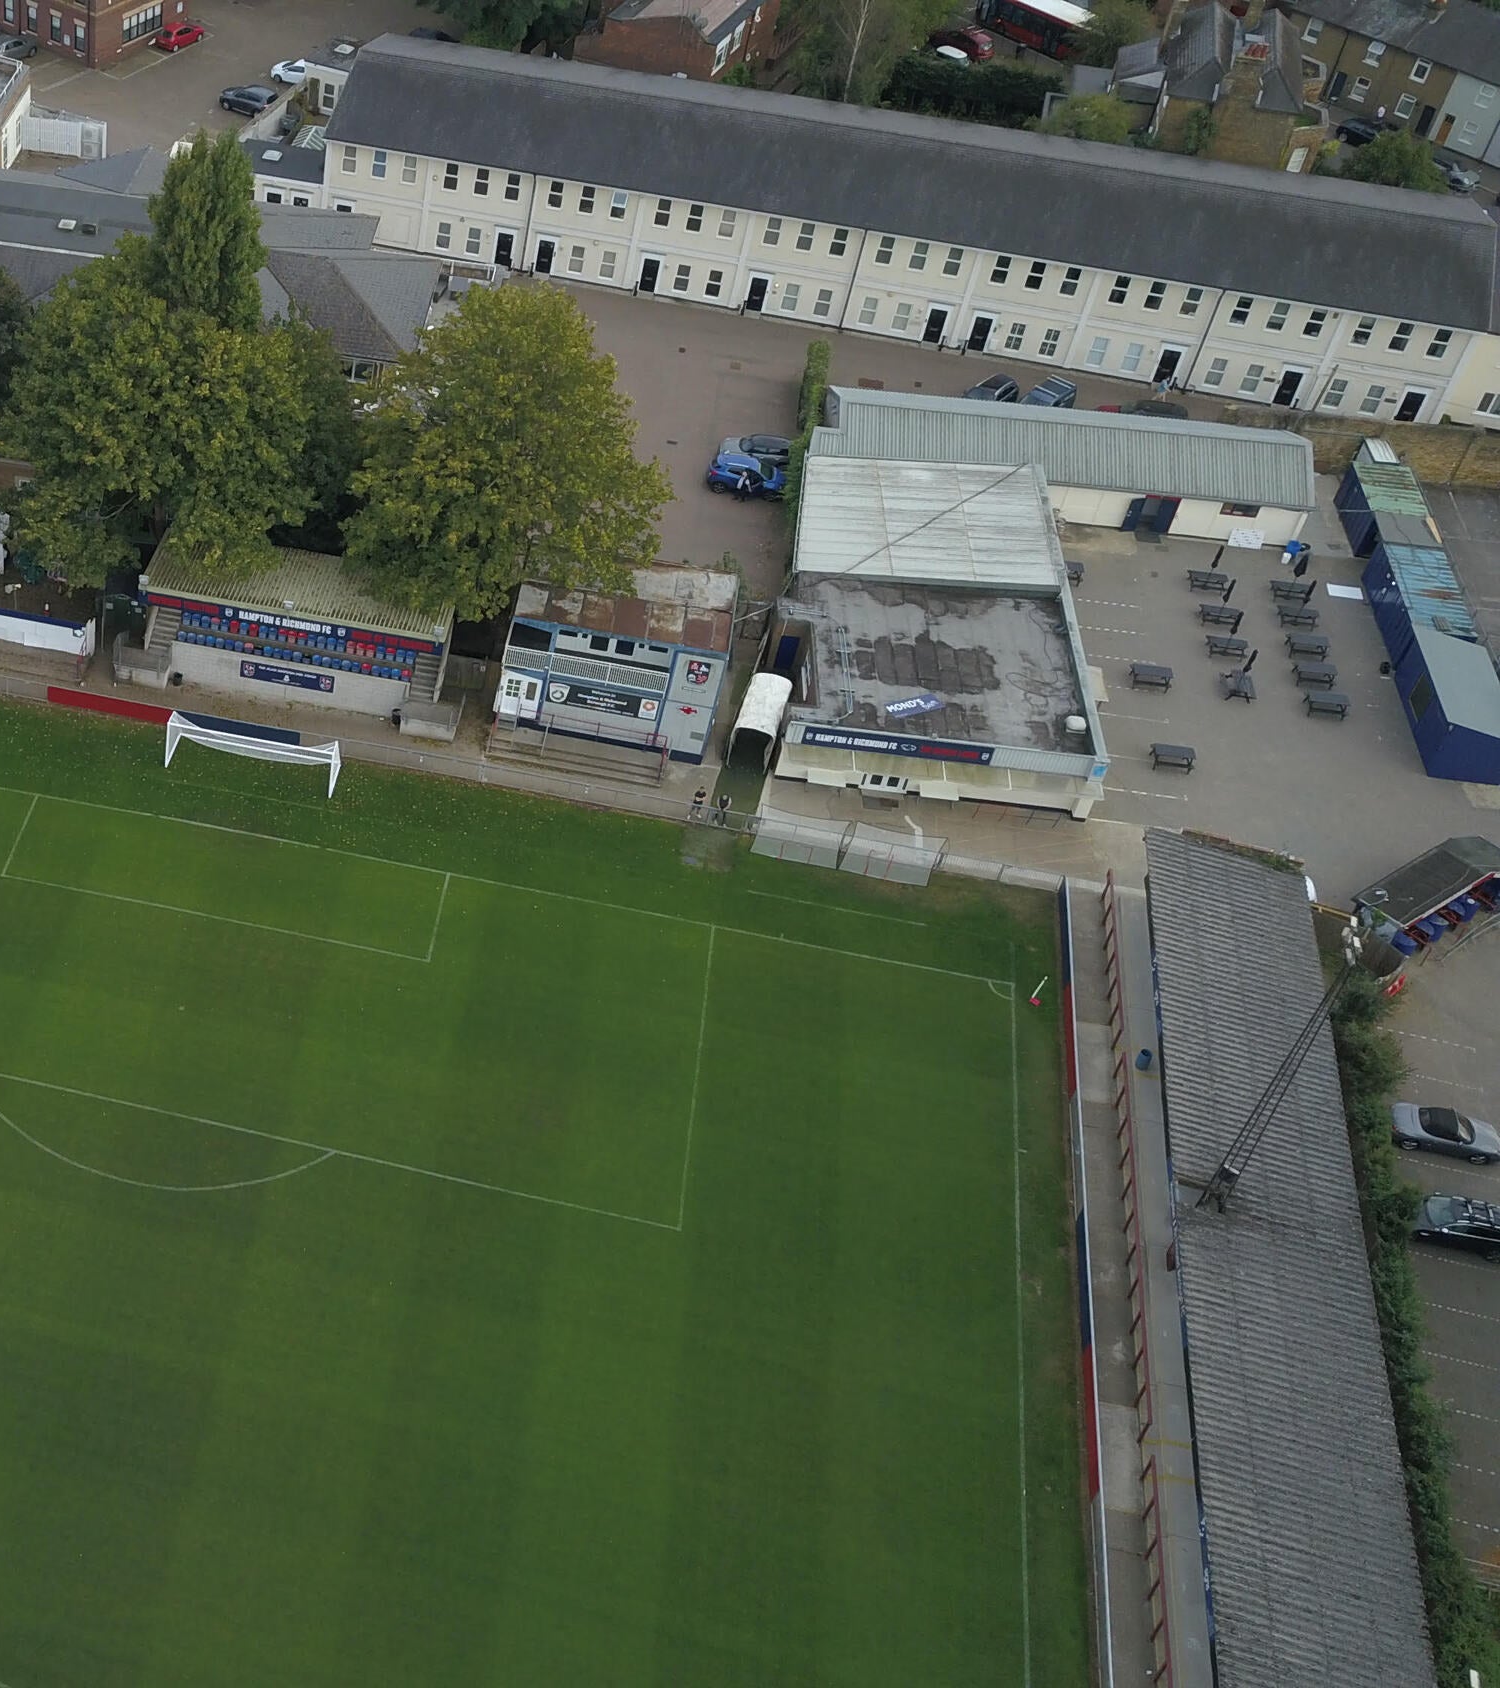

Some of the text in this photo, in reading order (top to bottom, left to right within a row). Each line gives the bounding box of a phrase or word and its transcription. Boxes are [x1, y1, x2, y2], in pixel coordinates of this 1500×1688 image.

[238, 610, 332, 635] HAMPTON & RICHMOND FC
[814, 733, 848, 744] HAMPTON
[853, 737, 889, 749] RICHMOND
[888, 742, 898, 750] FC
